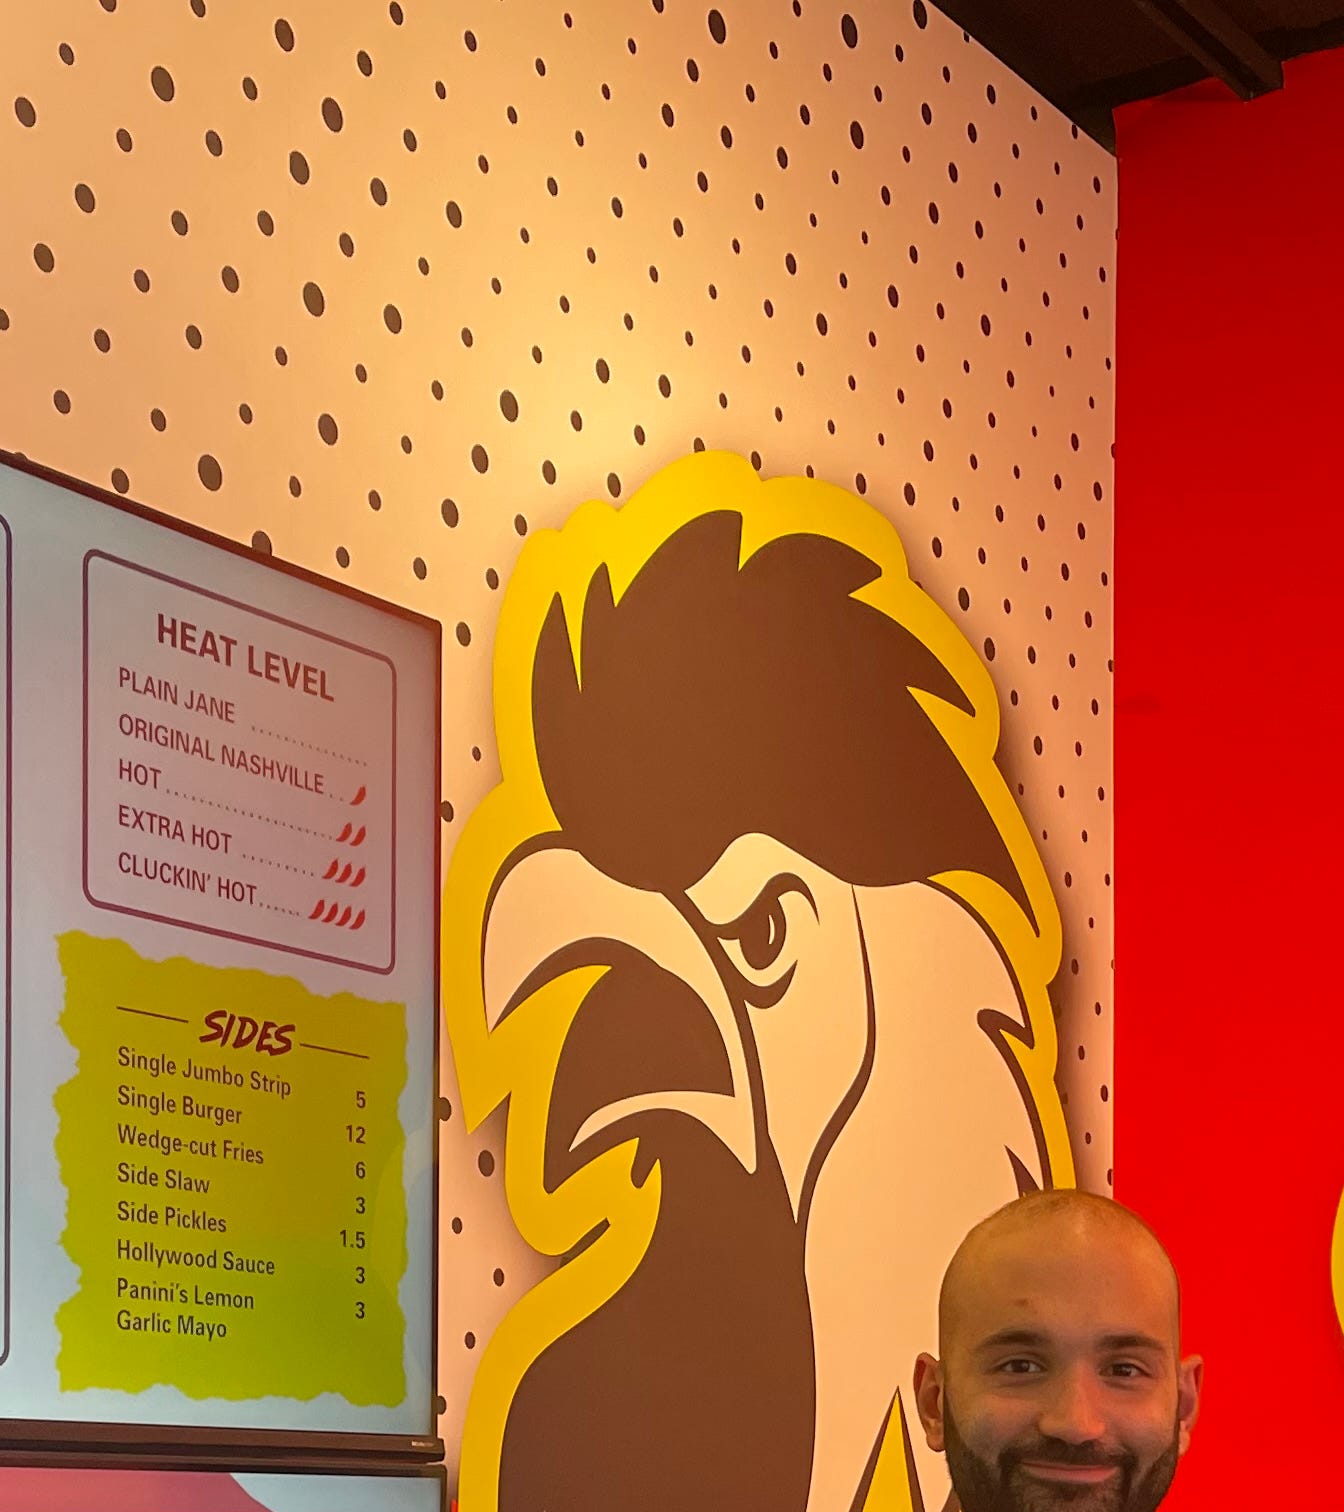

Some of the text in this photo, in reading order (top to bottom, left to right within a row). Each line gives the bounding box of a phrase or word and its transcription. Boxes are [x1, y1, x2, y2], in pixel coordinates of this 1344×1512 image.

[158, 613, 334, 701] HEAT LEVEL
[119, 667, 234, 723] PLAIN JANE
[119, 714, 323, 794] ORIGINAL NASHVILLE
[119, 759, 161, 789] HOT
[119, 804, 232, 853] EXTRA HOT
[118, 852, 256, 904] CLUCKIN' HOT
[199, 1010, 296, 1056] SIDES
[118, 1046, 291, 1099] Single Jumbo Strip
[118, 1085, 242, 1126] Single Burger
[356, 1091, 366, 1109] 5
[118, 1123, 263, 1164] Wedge-cut Fries
[346, 1125, 365, 1144] 12
[118, 1162, 209, 1193] Side Slaw
[356, 1161, 365, 1179] 6
[117, 1201, 226, 1232] Side Pickles
[356, 1197, 365, 1214] 3
[340, 1230, 365, 1249] 1.5
[118, 1239, 274, 1275] Hollywood Sauce
[356, 1266, 365, 1284] 3
[118, 1277, 253, 1309] Panini's Lemon
[117, 1310, 226, 1341] Garlic Mayo
[356, 1301, 365, 1319] 3
